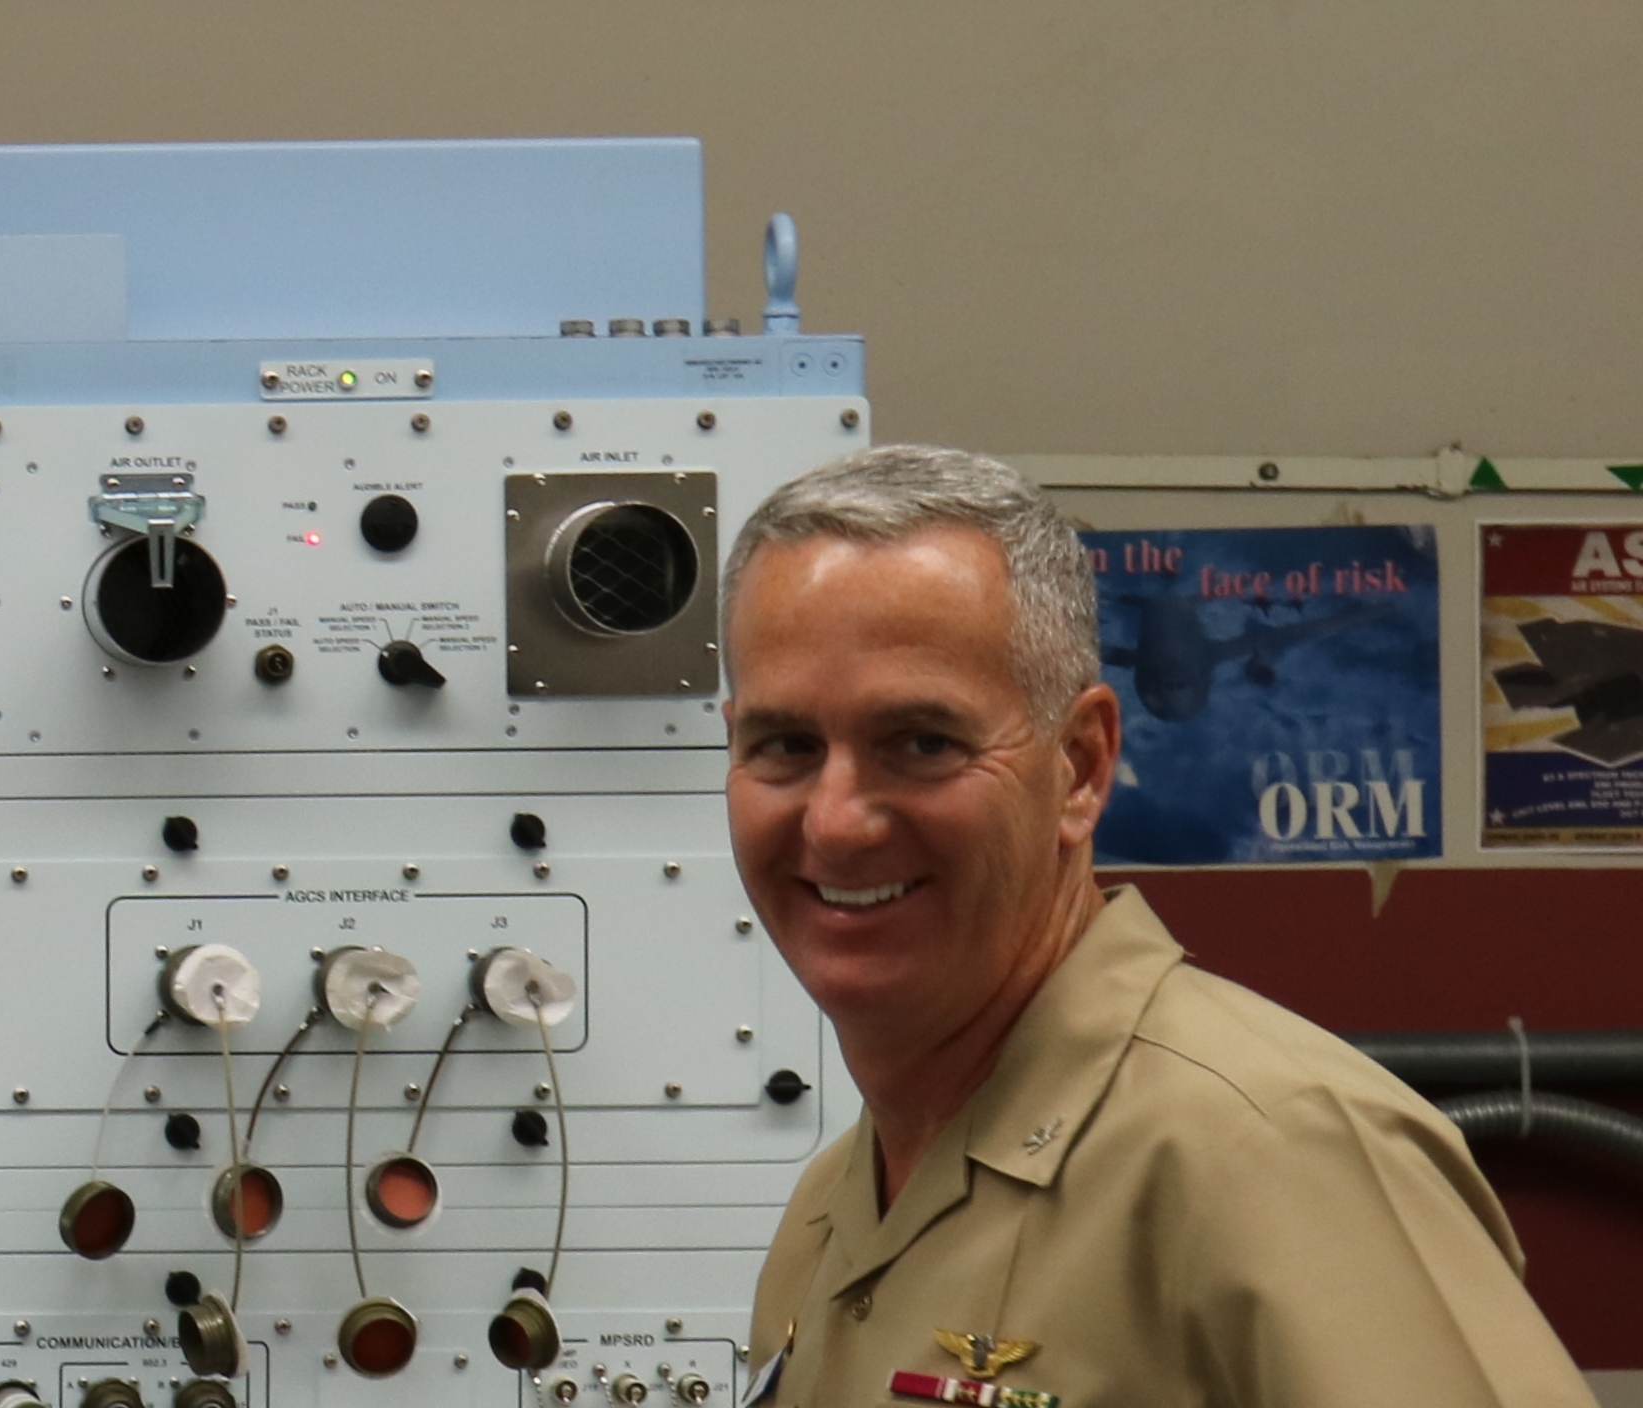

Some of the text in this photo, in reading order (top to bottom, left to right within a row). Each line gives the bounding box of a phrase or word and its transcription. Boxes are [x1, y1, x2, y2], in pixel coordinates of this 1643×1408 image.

[285, 364, 327, 378] RACK
[374, 371, 397, 385] ON
[279, 379, 335, 394] POWER
[111, 457, 181, 468] AIR OUTLET
[580, 451, 640, 464] AIR INLET
[353, 483, 392, 491] AUDIBLE
[283, 502, 306, 510] PASS
[1089, 540, 1184, 574] n the
[1200, 560, 1407, 598] face of risk
[340, 602, 460, 612] AUTO MANUAL SWITCH
[246, 618, 301, 627] PASS FAIL
[255, 629, 292, 638] STATUS
[1259, 780, 1425, 840] ORM
[285, 890, 409, 903] AGCS INTERFACE
[187, 918, 202, 931] J1
[339, 918, 355, 930] J2
[491, 917, 507, 929] J3
[37, 1337, 181, 1350] COMMUNICATION/B
[600, 1334, 654, 1347] MPSRD
